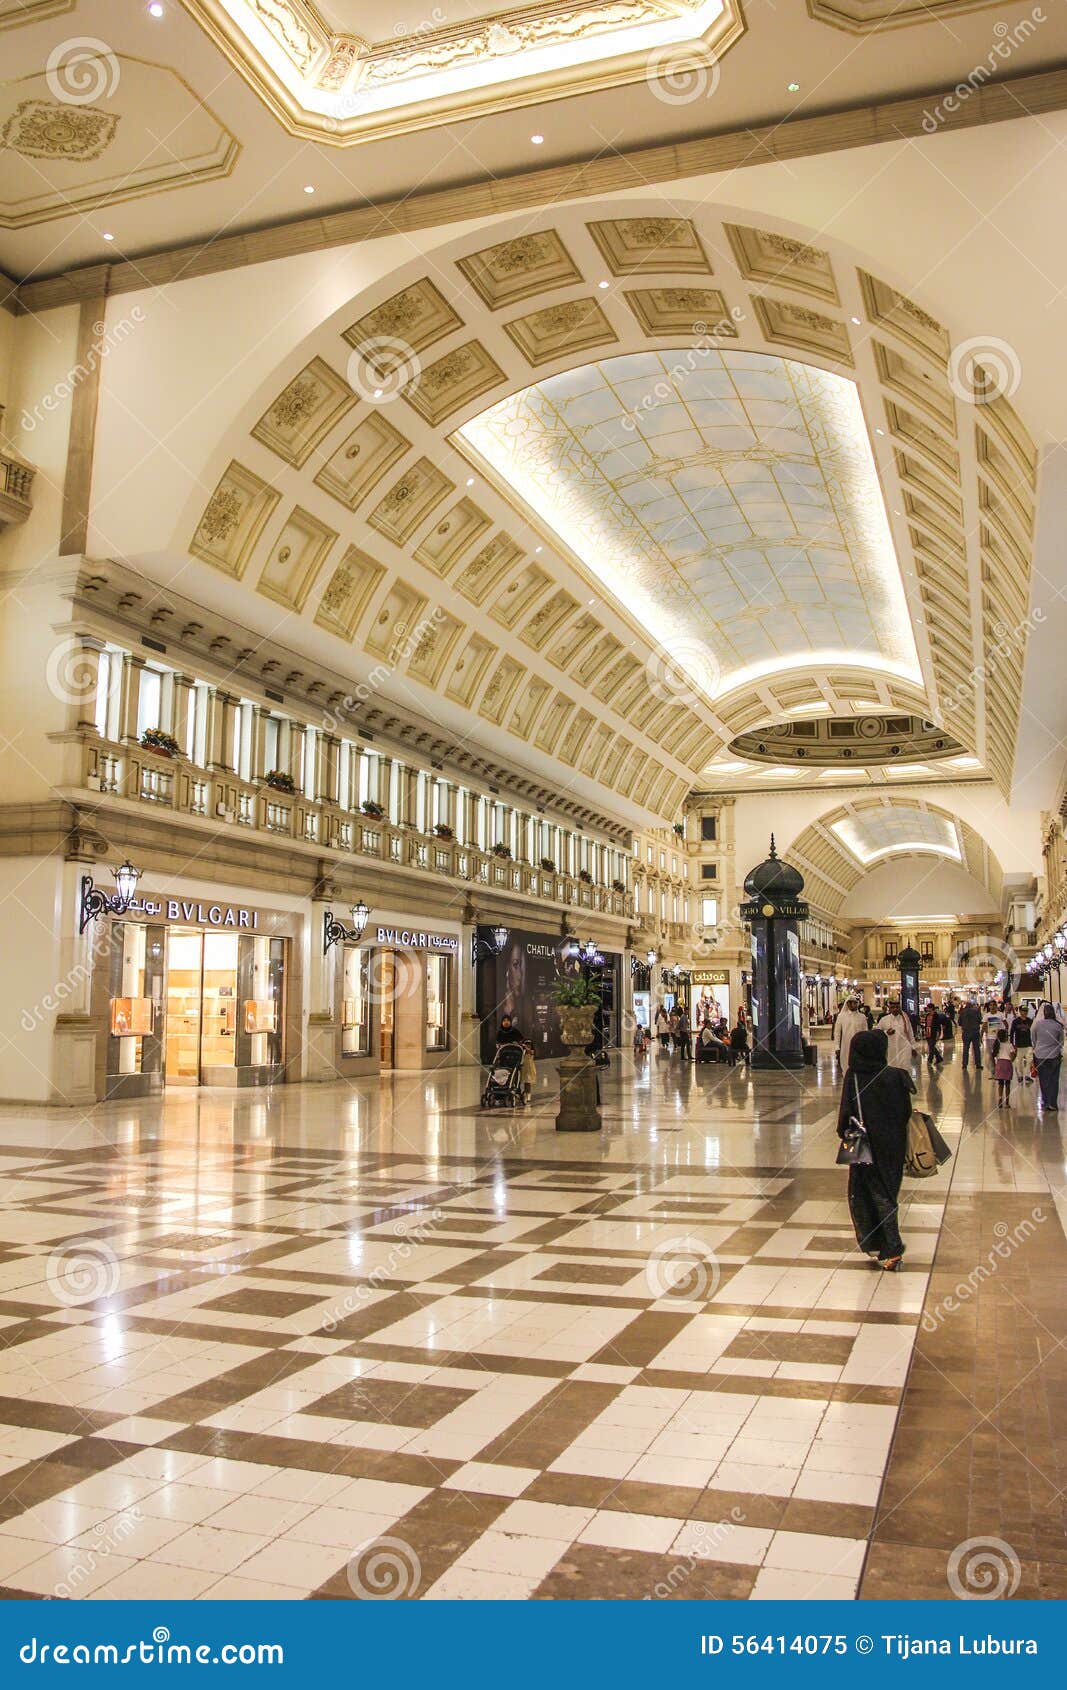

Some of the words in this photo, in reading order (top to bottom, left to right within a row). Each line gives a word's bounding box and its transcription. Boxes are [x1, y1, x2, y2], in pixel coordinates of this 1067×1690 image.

[167, 900, 258, 928] BVLGARI
[377, 928, 431, 947] BVLGARI
[526, 943, 556, 957] CHATILA
